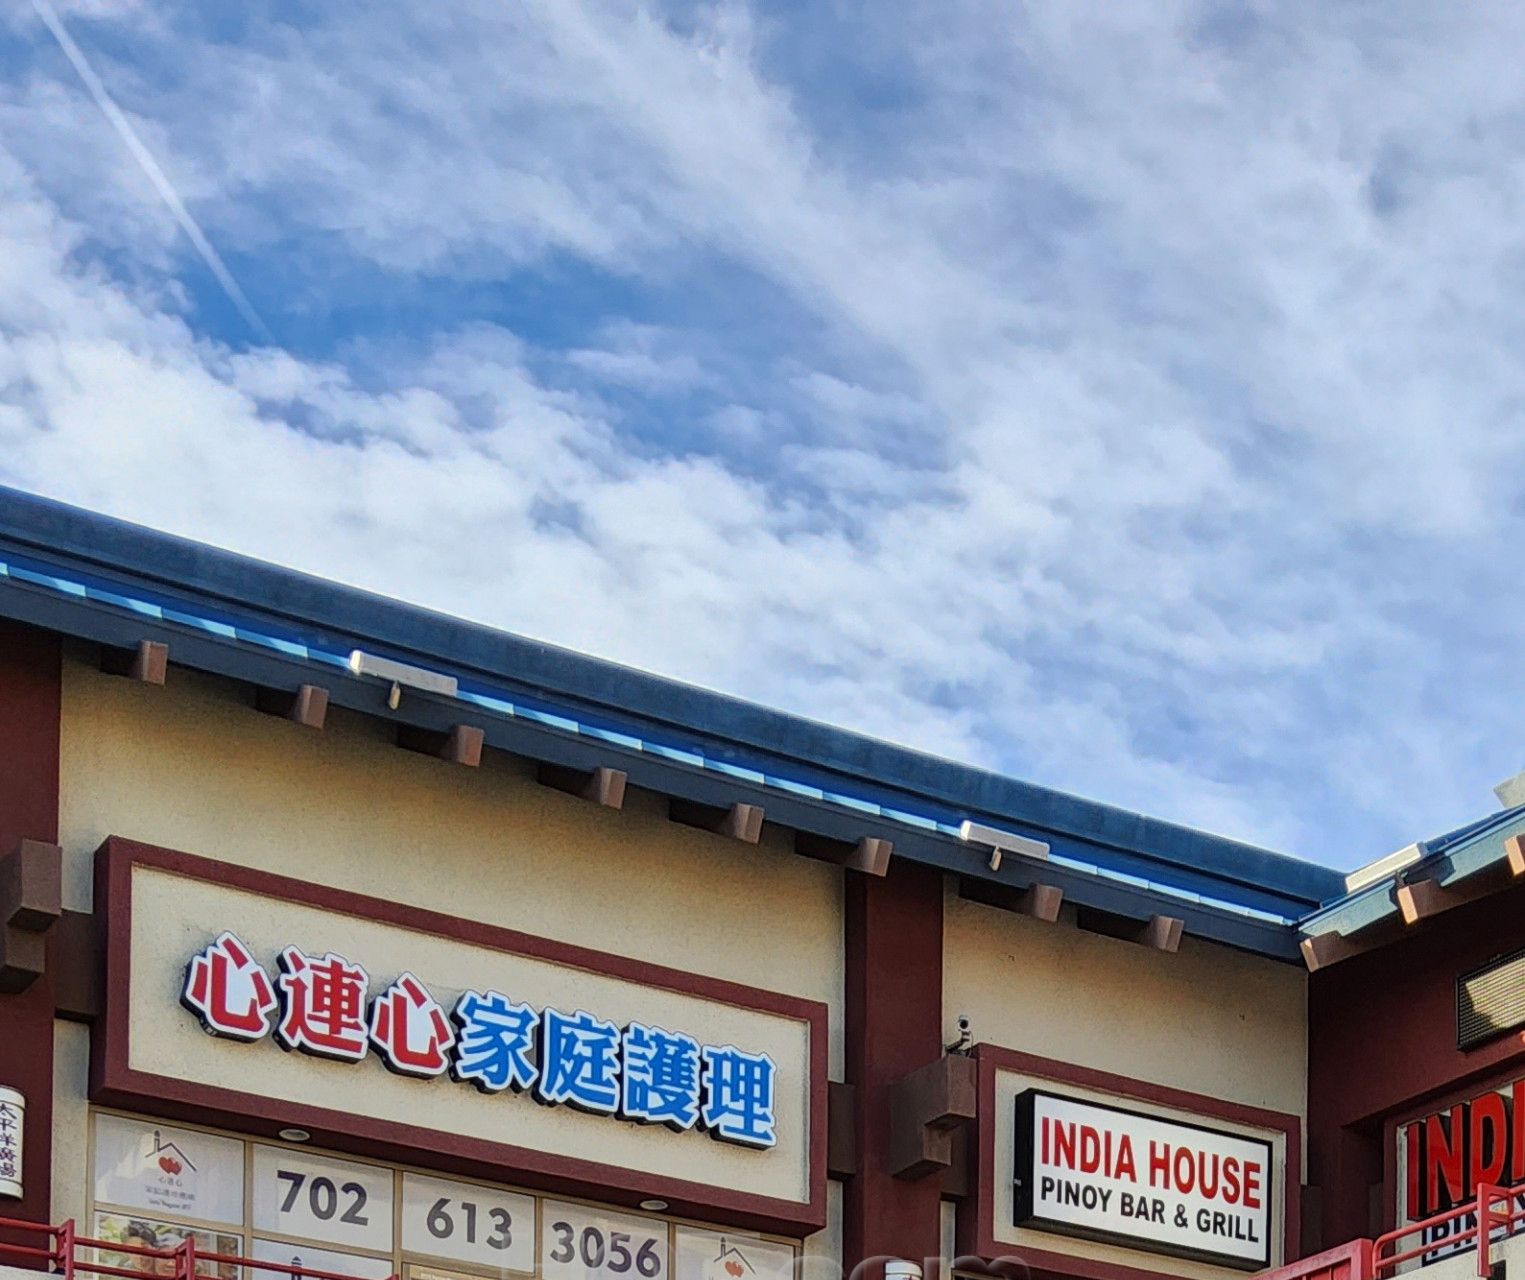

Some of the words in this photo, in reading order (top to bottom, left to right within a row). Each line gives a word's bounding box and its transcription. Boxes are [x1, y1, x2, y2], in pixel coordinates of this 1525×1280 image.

[184, 933, 777, 1145] 心連心家庭護理
[1041, 1116, 1137, 1183] INDIA
[1149, 1140, 1261, 1209] HOUSE
[1041, 1176, 1112, 1212] PINOY
[1120, 1192, 1165, 1224] BAR
[1174, 1203, 1188, 1228] &
[1196, 1208, 1259, 1243] GRILL
[277, 1169, 369, 1227] 702
[426, 1198, 513, 1250] 613
[550, 1221, 662, 1278] 3056
